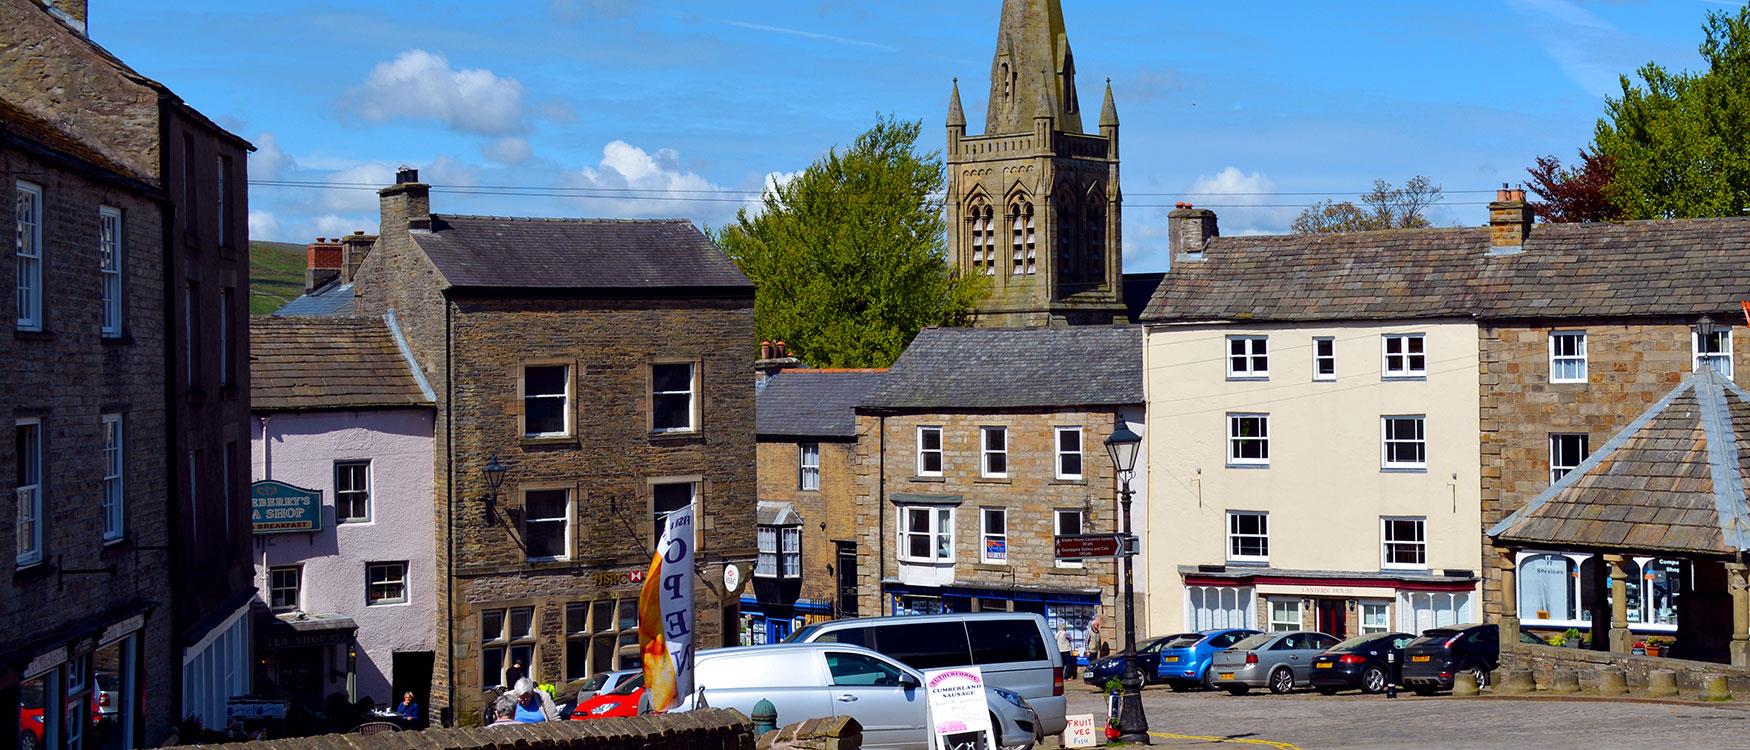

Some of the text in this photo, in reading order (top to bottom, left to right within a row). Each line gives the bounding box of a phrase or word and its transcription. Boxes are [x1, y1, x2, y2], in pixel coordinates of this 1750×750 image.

[266, 507, 305, 519] SHOP
[1537, 567, 1564, 575] Services
[593, 571, 628, 586] HSBC
[932, 684, 982, 693] CUMBERLAND
[1066, 718, 1092, 727] FRUIT
[1073, 728, 1090, 736] VEG
